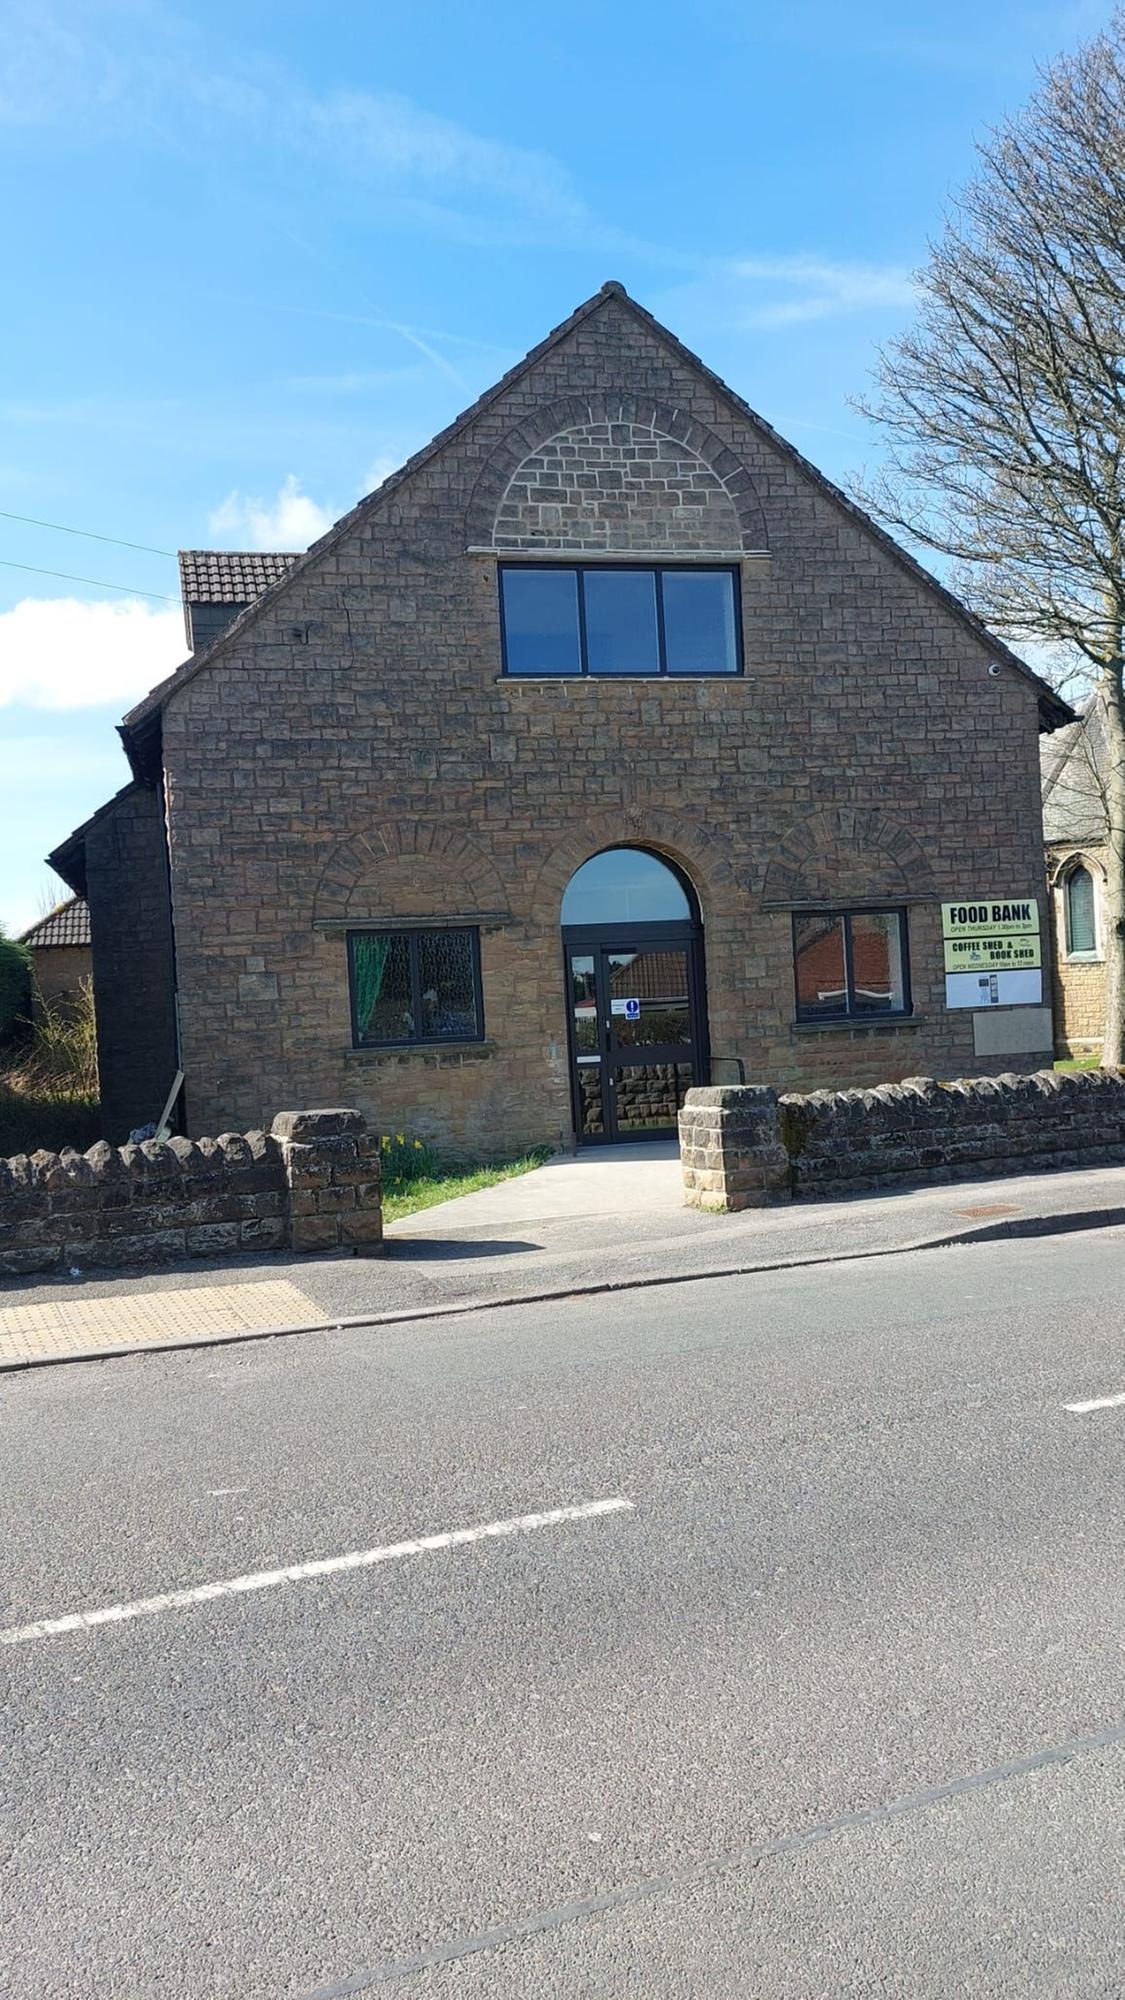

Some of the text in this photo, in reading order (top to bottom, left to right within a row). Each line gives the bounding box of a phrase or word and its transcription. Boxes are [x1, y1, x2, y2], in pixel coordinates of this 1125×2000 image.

[950, 904, 1031, 924] FOOD BANK
[951, 925, 966, 933] OPEN
[967, 924, 997, 932] THURSDAY
[952, 941, 1013, 952] COFFEE SHED &
[990, 949, 1034, 960] BOOK SHED
